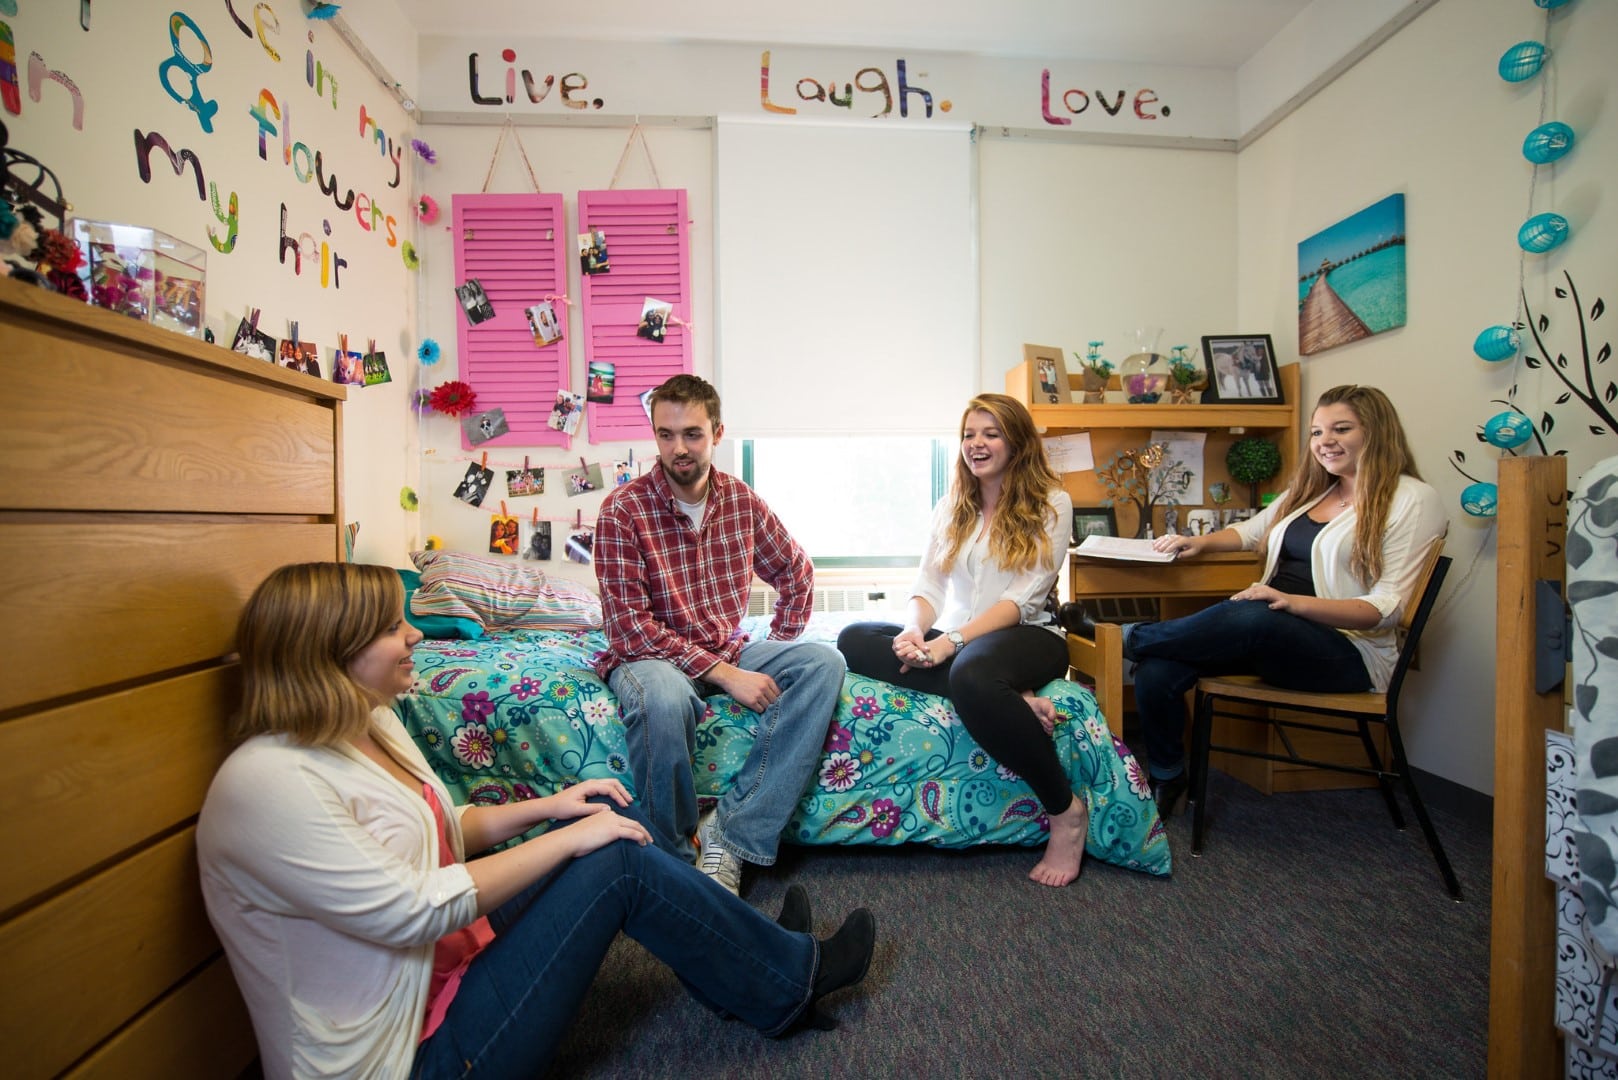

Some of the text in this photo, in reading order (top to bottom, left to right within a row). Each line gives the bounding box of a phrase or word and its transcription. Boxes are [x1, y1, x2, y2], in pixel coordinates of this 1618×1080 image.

[305, 29, 401, 188] in my
[469, 48, 604, 110] Live.
[760, 50, 953, 118] Laugh.
[1041, 68, 1172, 126] Love.
[159, 11, 218, 134] &
[249, 88, 397, 247] flowers
[134, 128, 239, 254] my
[279, 202, 348, 289] hair
[1546, 492, 1564, 558] VTC
